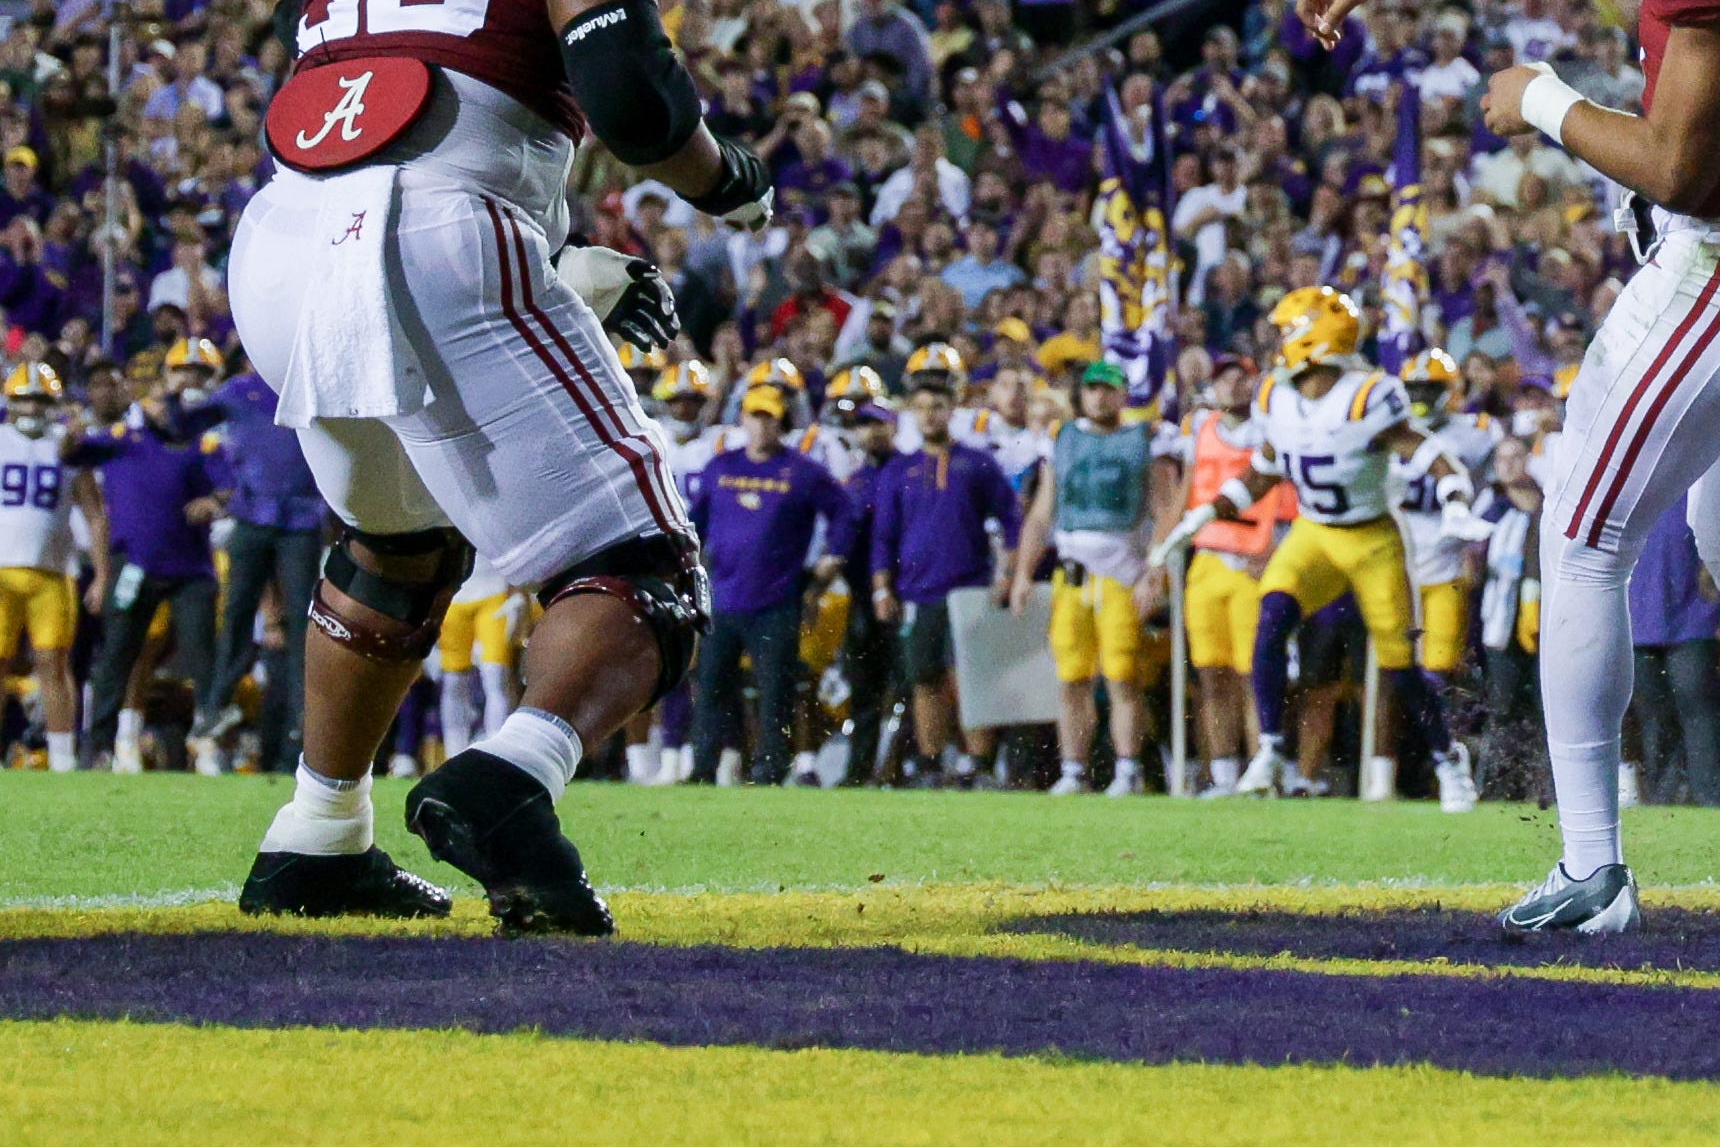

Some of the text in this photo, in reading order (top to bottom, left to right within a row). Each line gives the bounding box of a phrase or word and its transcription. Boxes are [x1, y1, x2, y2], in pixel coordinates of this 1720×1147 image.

[296, 71, 373, 149] A
[3, 464, 61, 509] 98
[1283, 453, 1349, 515] 15
